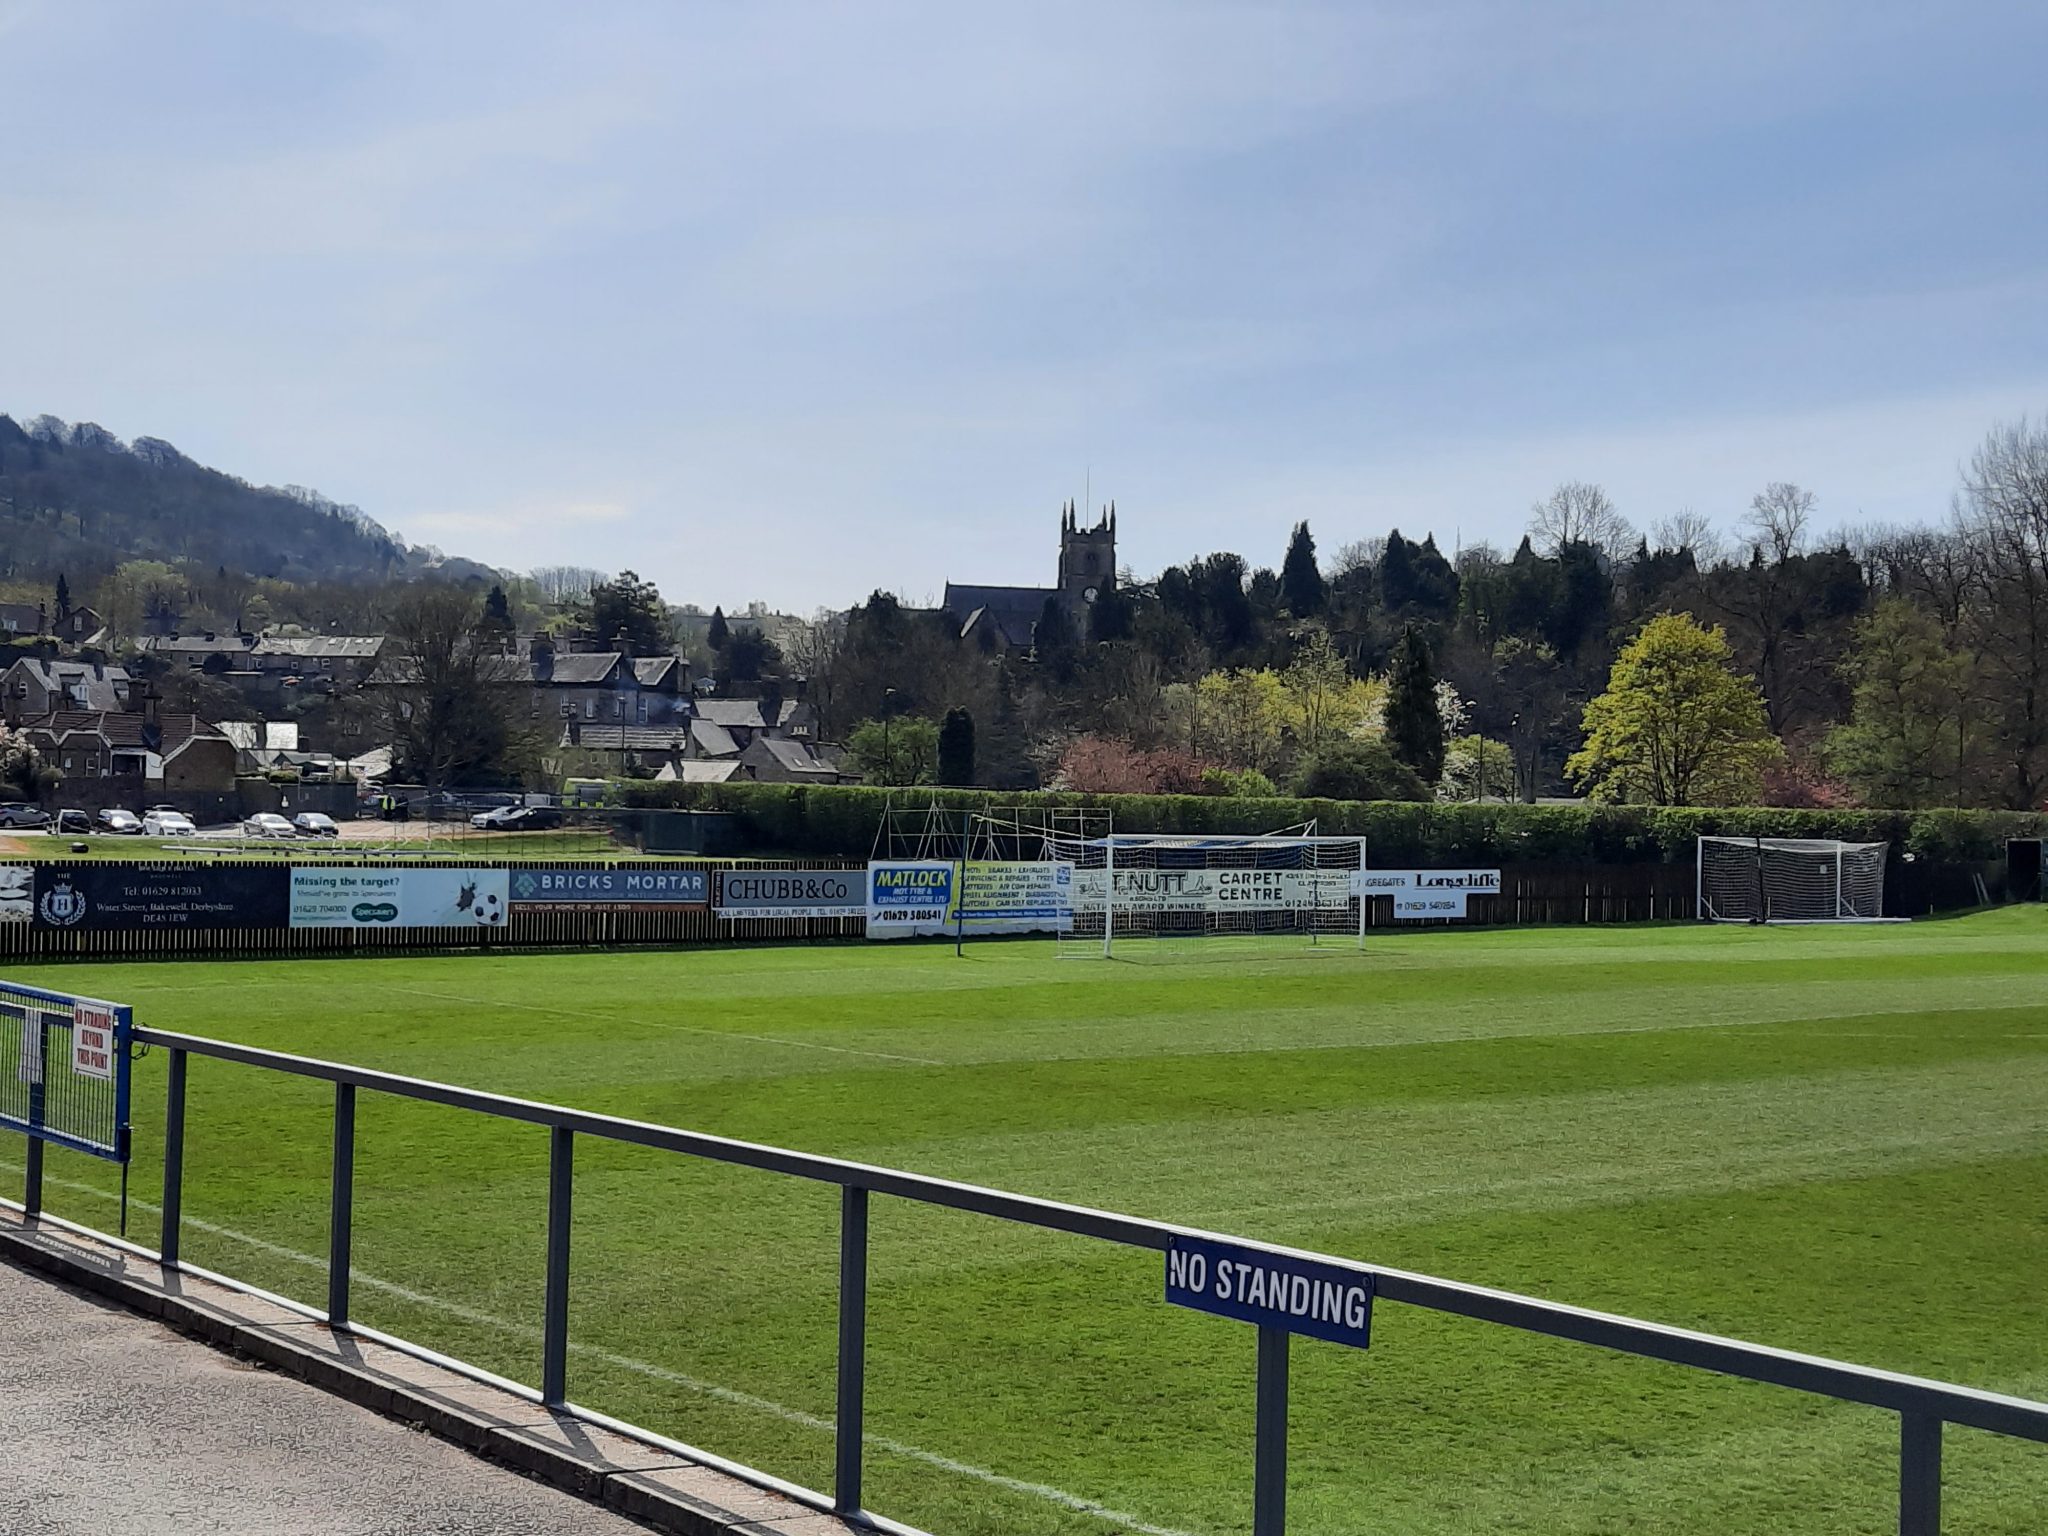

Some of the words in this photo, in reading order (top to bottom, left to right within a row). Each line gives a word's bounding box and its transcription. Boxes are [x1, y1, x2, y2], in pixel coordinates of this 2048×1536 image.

[294, 877, 337, 888] Missing
[340, 877, 357, 886] the
[361, 877, 400, 888] target?
[541, 875, 613, 889] BRICKS
[627, 876, 702, 889] MORTAR
[876, 871, 948, 886] MATLOCK
[1220, 872, 1282, 884] CARPET
[1416, 873, 1499, 888] Longcliffe
[142, 887, 168, 896] 01629
[728, 879, 847, 899] CHUBB&Co
[1219, 888, 1282, 900] CENTRE
[883, 911, 908, 920] 01629
[77, 1048, 89, 1066] THIS
[91, 1050, 107, 1070] POINT
[1170, 1249, 1207, 1293] NO
[1215, 1259, 1366, 1329] STANDING
